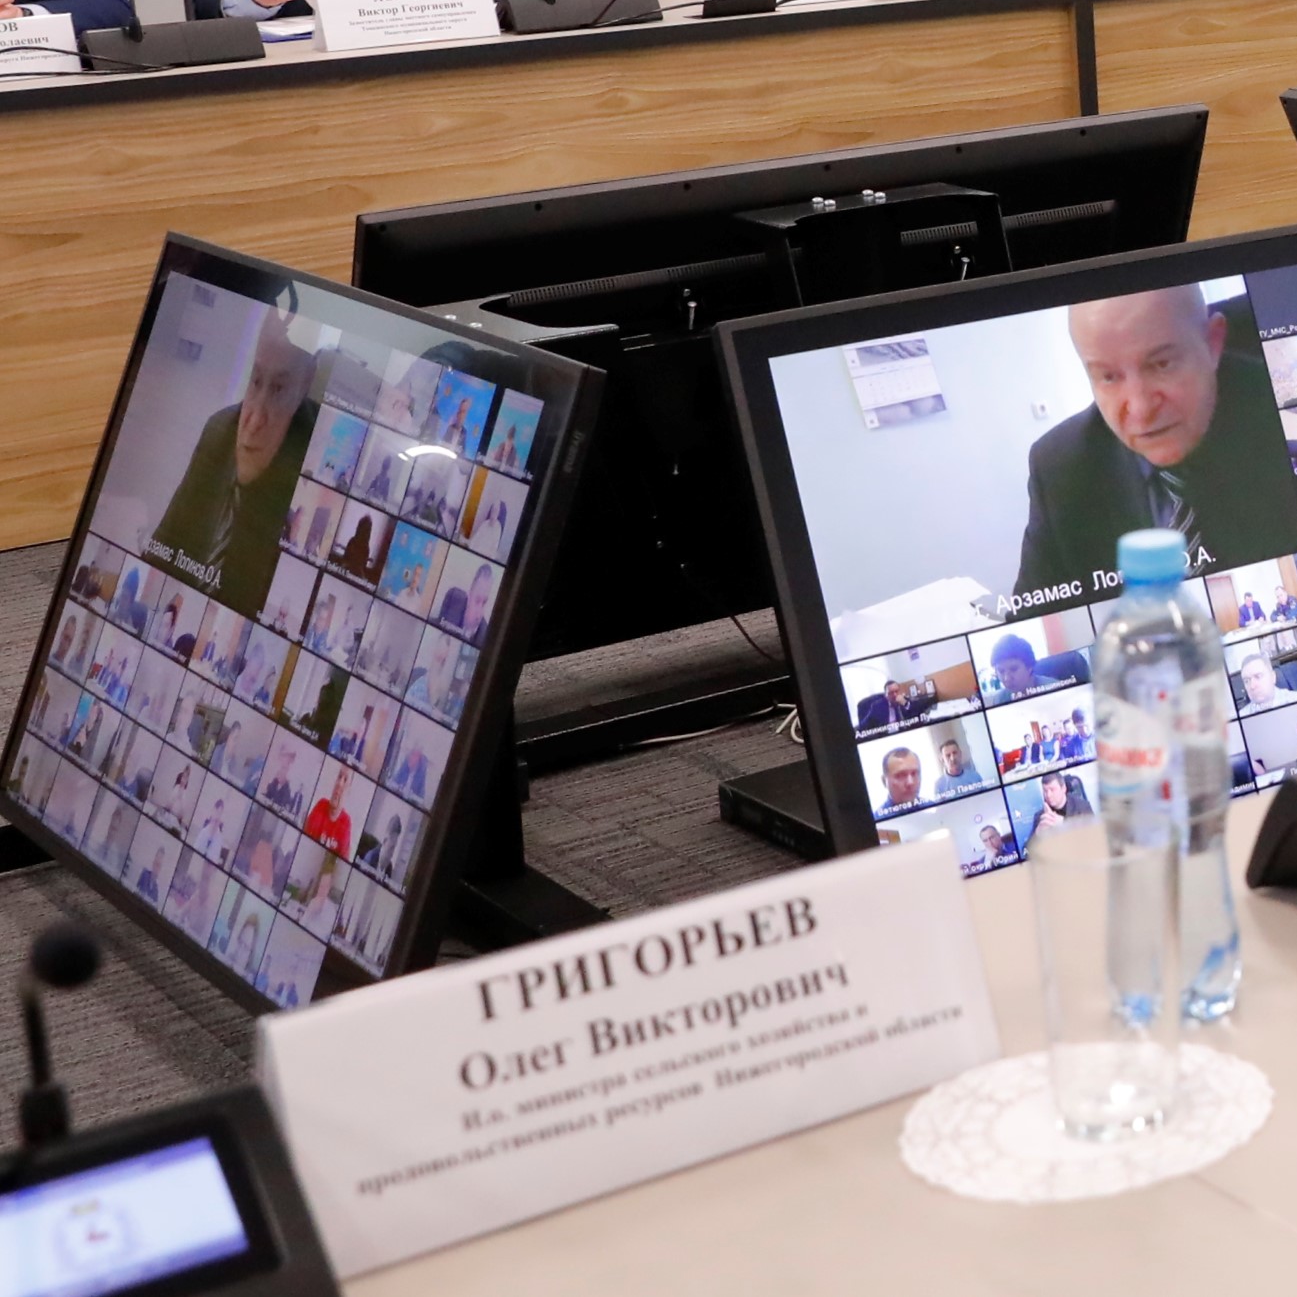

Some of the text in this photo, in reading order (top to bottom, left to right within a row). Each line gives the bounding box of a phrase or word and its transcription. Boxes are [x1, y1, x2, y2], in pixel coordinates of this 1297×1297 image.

[358, 1, 464, 17] Виктор Георгиевич
[996, 578, 1083, 615] Арзамас
[474, 895, 819, 1023] ГРИГОРЬЕВ
[459, 962, 851, 1091] Олег Викторович
